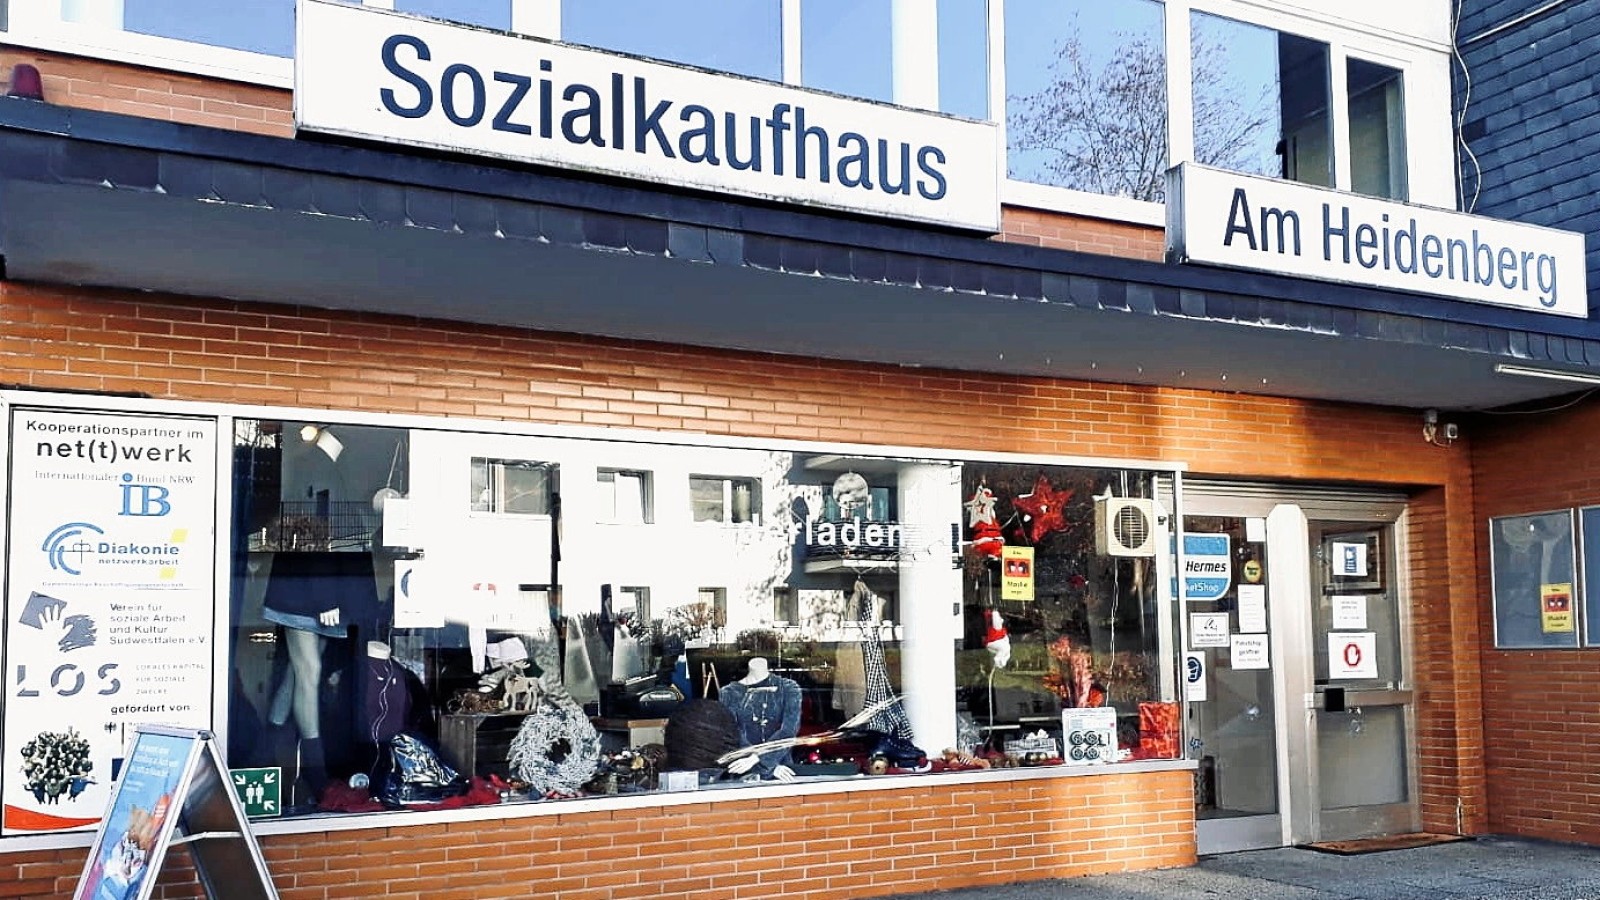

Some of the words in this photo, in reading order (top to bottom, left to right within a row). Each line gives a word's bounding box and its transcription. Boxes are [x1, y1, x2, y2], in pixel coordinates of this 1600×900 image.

[379, 34, 947, 200] Sozialkaufhaus
[1223, 188, 1301, 256] Am
[1322, 203, 1557, 307] Heidenberg
[26, 420, 182, 438] Kooperationspartner
[187, 430, 204, 439] im
[37, 439, 191, 463] net(t)werk
[36, 470, 118, 481] Internationaler
[98, 542, 180, 555] Diakonie
[1186, 561, 1226, 572] Hermes
[110, 603, 145, 612] Verein
[111, 614, 149, 623] soziale
[153, 614, 186, 623] Arbeit
[110, 626, 131, 634] und
[135, 625, 169, 634] Kultur
